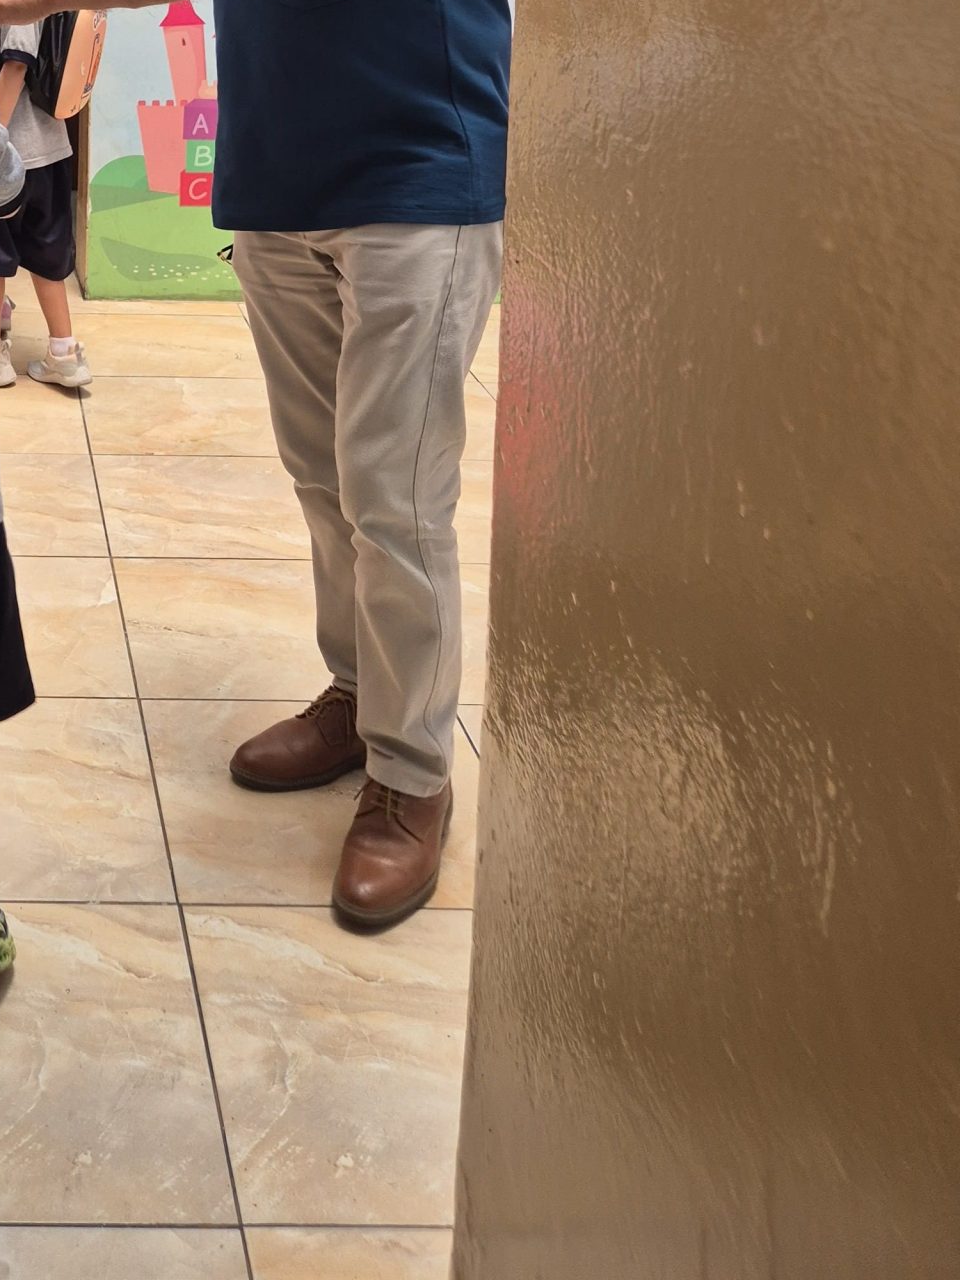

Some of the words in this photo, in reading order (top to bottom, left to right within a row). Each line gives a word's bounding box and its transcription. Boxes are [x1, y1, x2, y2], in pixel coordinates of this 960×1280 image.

[192, 113, 209, 135] A
[194, 145, 213, 167] B
[189, 178, 208, 200] C
